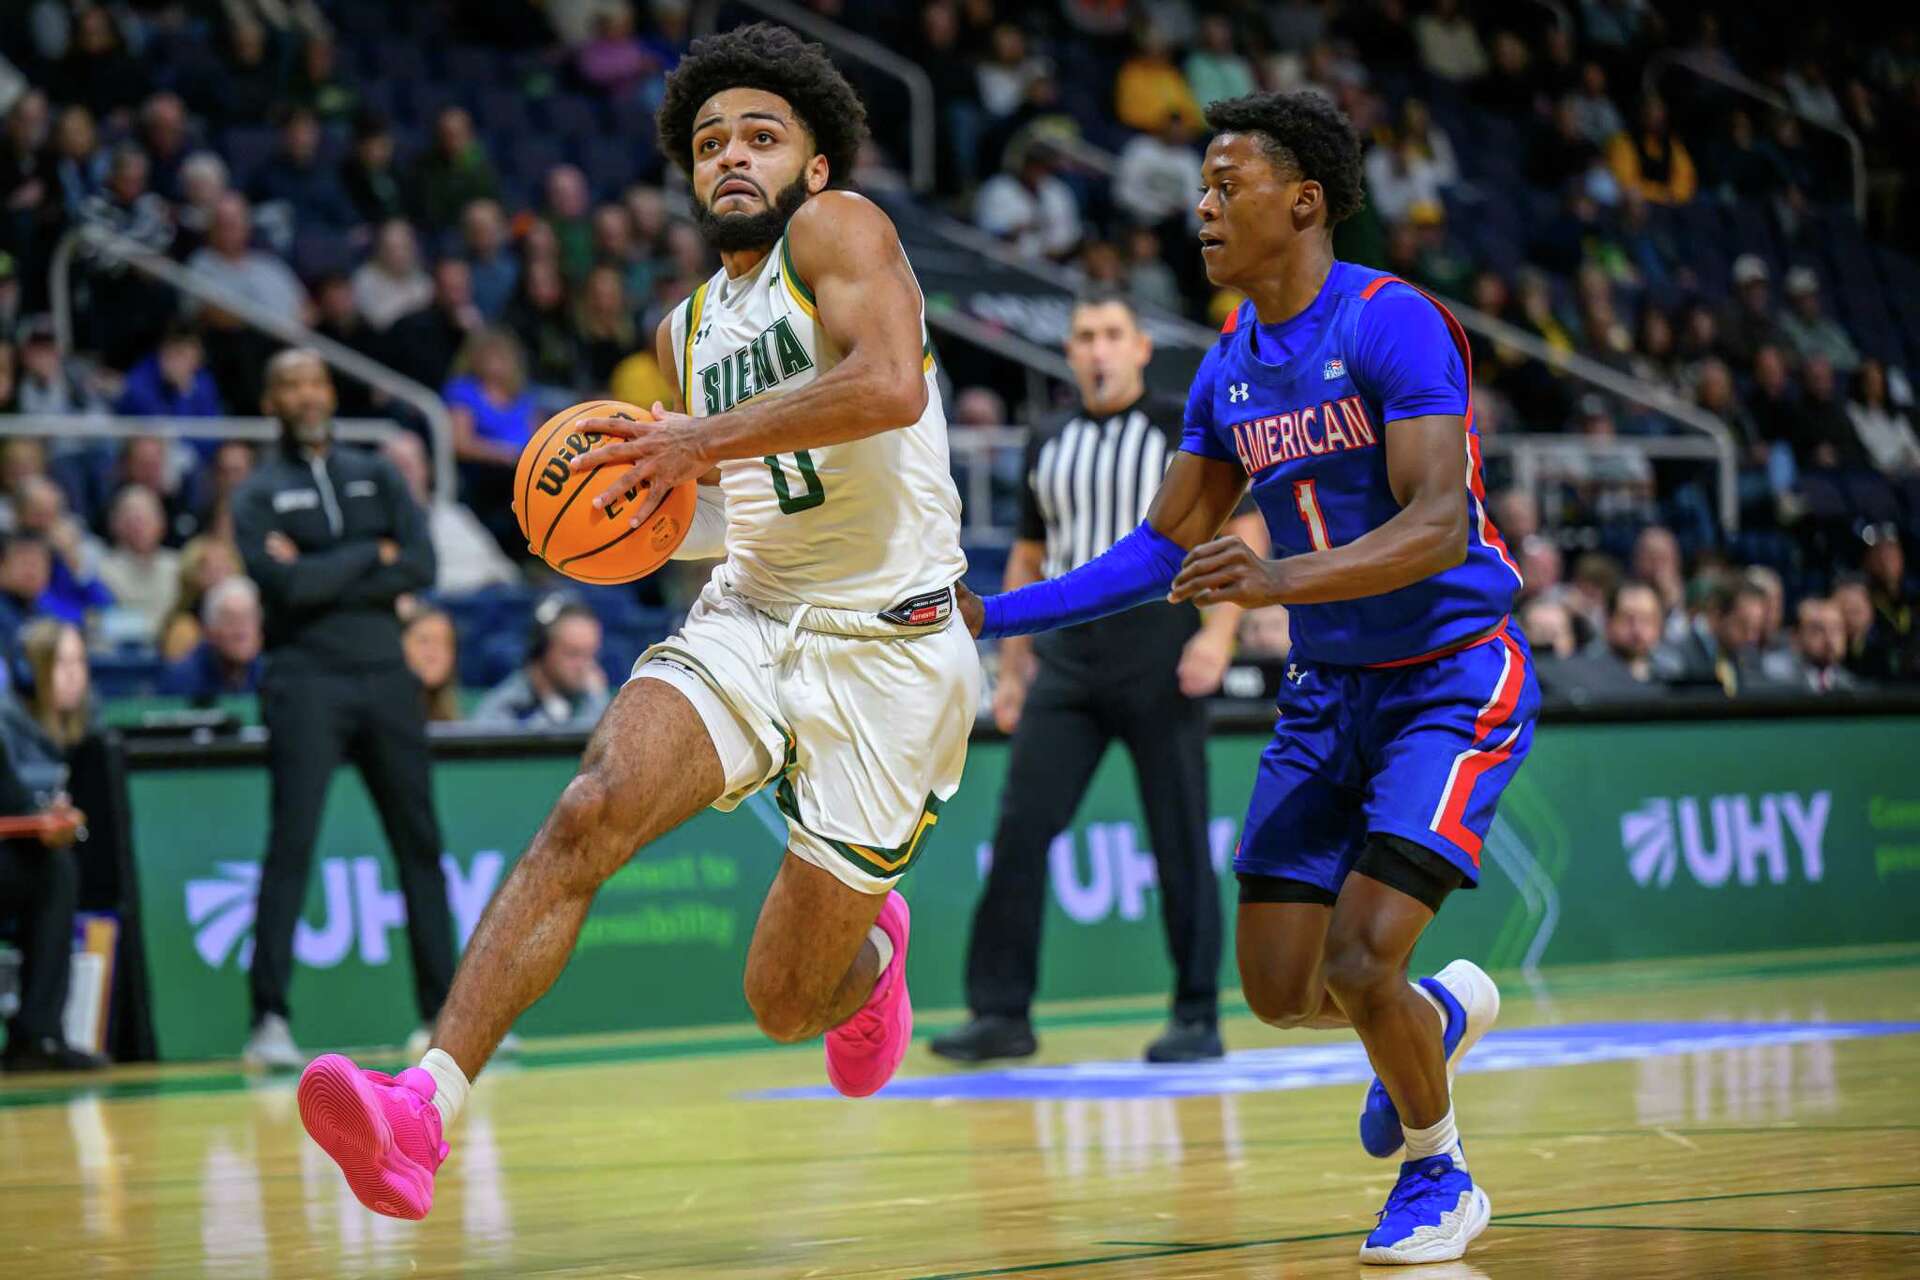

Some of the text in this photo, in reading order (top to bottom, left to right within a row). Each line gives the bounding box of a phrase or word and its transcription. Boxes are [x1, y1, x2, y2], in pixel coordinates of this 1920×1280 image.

[696, 316, 814, 416] SIENA
[1231, 395, 1378, 478] AMERICAN
[1292, 479, 1332, 551] 1
[1676, 790, 1832, 888] UHY
